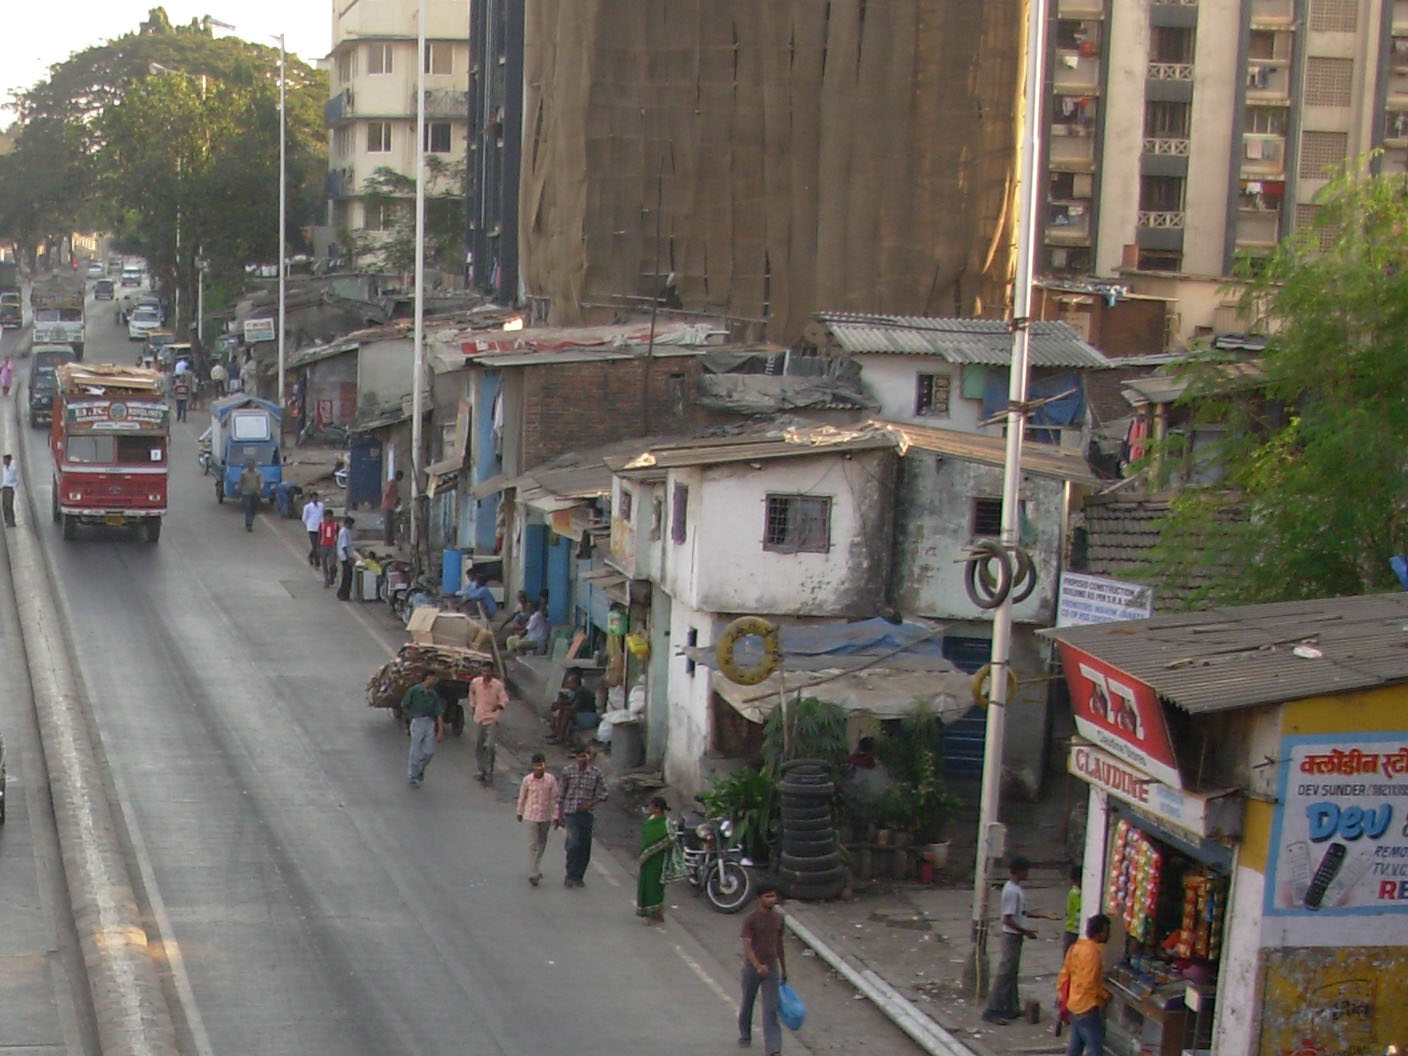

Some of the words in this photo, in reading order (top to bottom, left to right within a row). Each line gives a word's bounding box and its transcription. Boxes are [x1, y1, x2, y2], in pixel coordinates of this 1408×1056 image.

[1075, 748, 1150, 805] CLAUDINE
[1298, 784, 1319, 796] DEV
[1305, 801, 1393, 843] Dev
